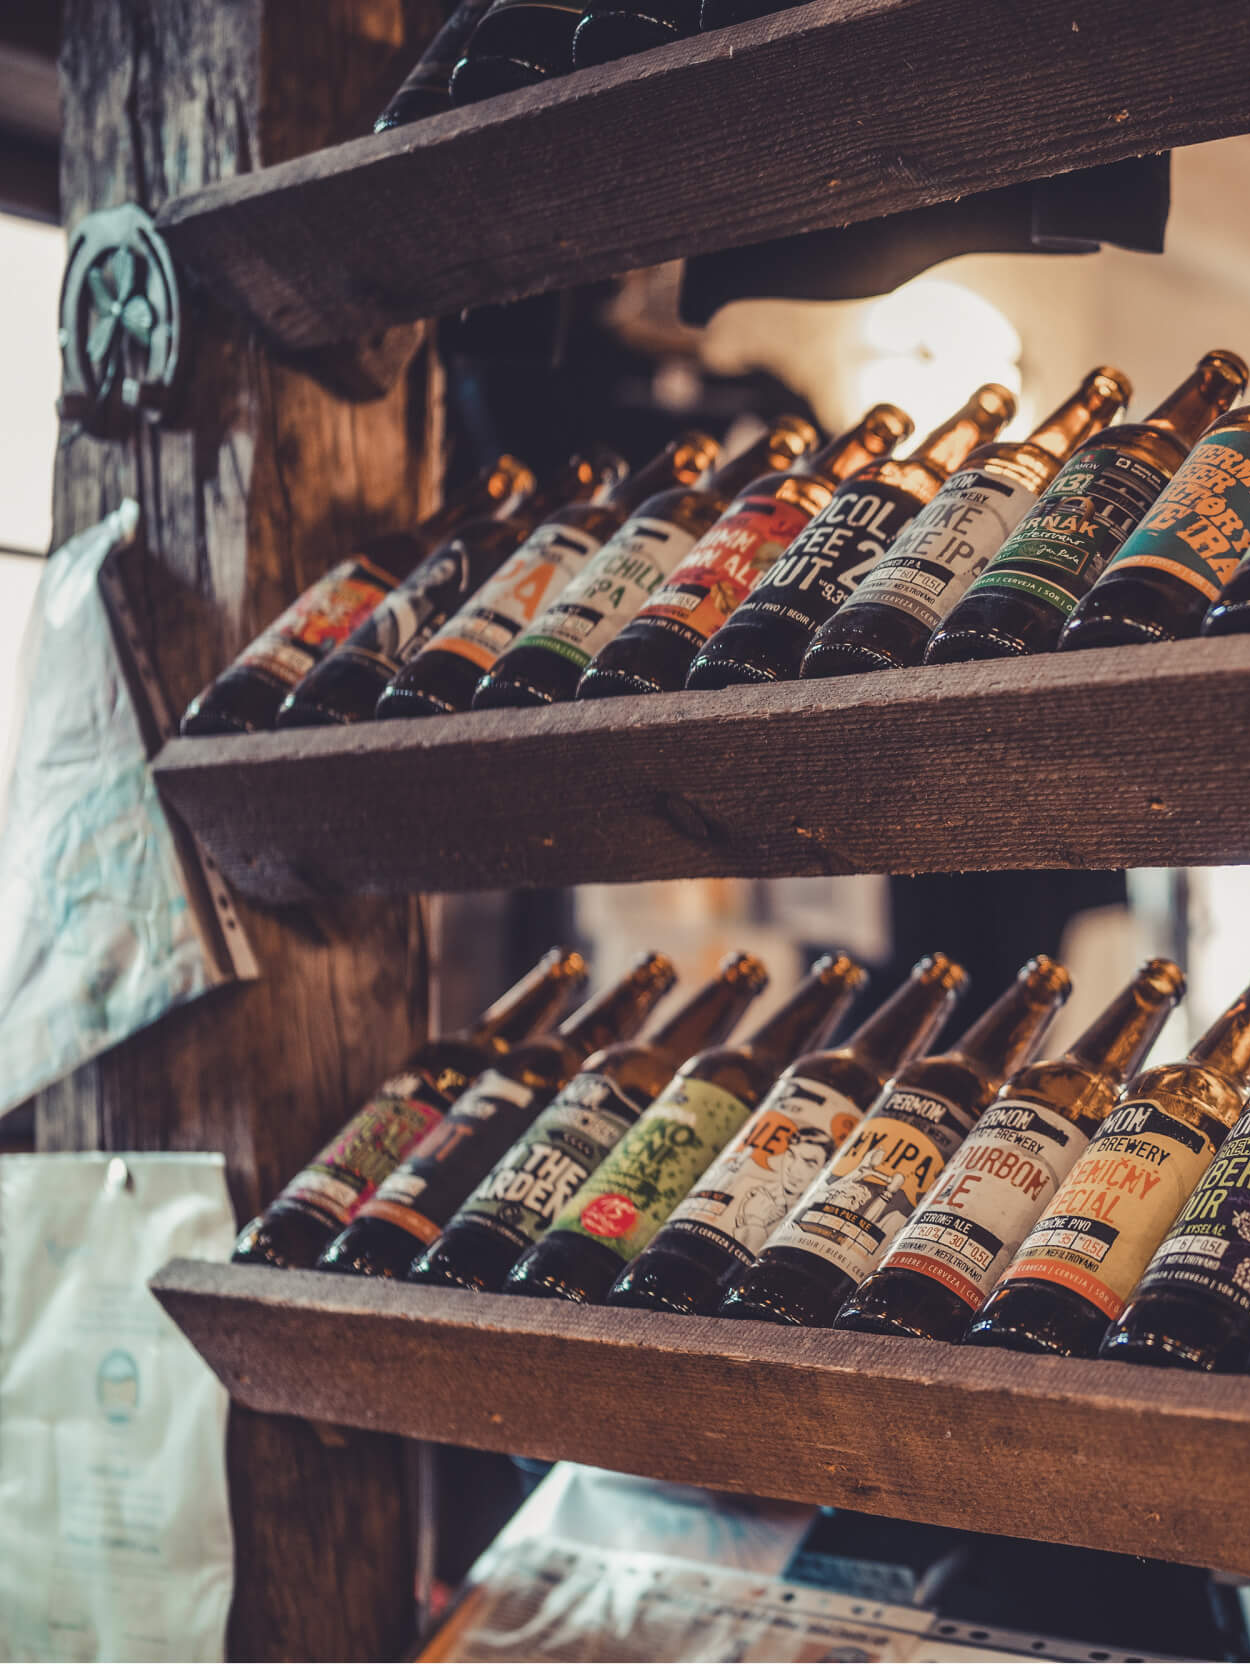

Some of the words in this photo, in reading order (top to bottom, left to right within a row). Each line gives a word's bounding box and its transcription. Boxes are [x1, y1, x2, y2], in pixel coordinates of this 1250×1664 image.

[885, 1092, 948, 1124] PERMON
[1096, 1106, 1153, 1136] MON
[993, 1127, 1045, 1156] BREWERY
[1096, 1136, 1172, 1167] BREWERY
[523, 1143, 588, 1190] THE
[884, 1138, 933, 1189] IPA
[954, 1144, 1051, 1202] OURBON
[1068, 1157, 1162, 1201] ENIČNÝ
[928, 1173, 983, 1209] LE
[1047, 1187, 1122, 1225] ECIÁL
[1175, 1188, 1229, 1222] UR
[919, 1212, 954, 1226] STRONG
[953, 1219, 974, 1235] ALE
[1068, 1218, 1092, 1232] PIVO
[948, 1233, 965, 1249] 30
[928, 1261, 961, 1289] CERVEZA
[1053, 1267, 1088, 1288] CERVEJA
[1173, 1270, 1210, 1286] CERVEJA
